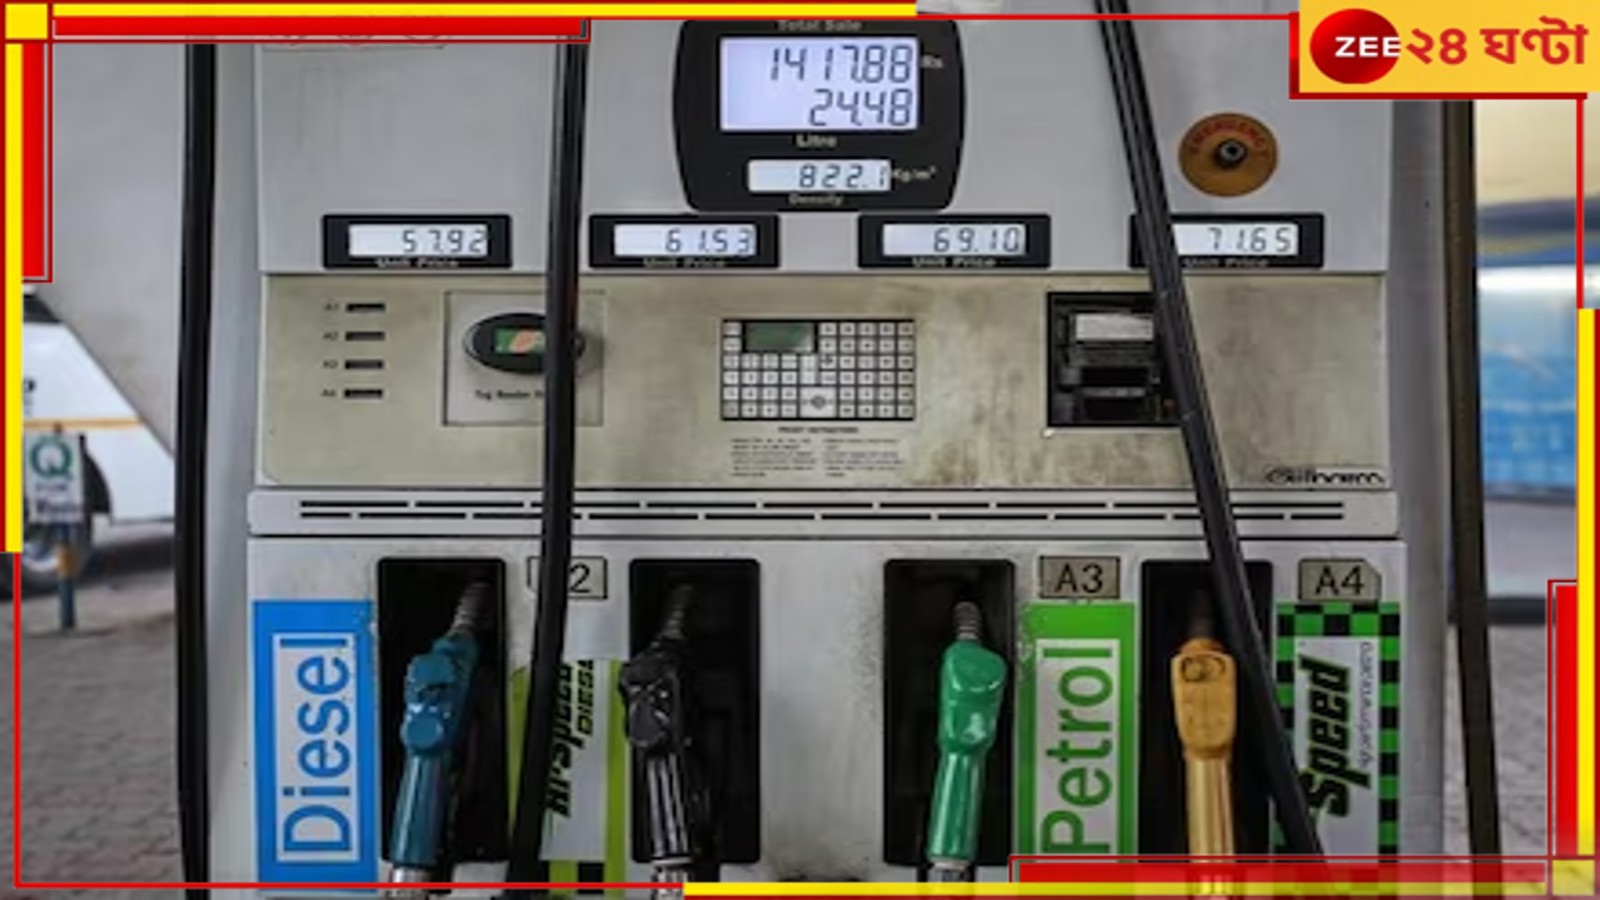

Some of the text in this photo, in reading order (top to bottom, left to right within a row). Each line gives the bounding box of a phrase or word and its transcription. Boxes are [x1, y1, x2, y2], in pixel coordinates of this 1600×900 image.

[796, 134, 837, 149] Litre
[1055, 563, 1104, 593] A3
[1315, 565, 1365, 596] A4
[279, 637, 352, 853] Diesel
[1041, 646, 1114, 854] Petrol
[1298, 654, 1371, 818] Speed
